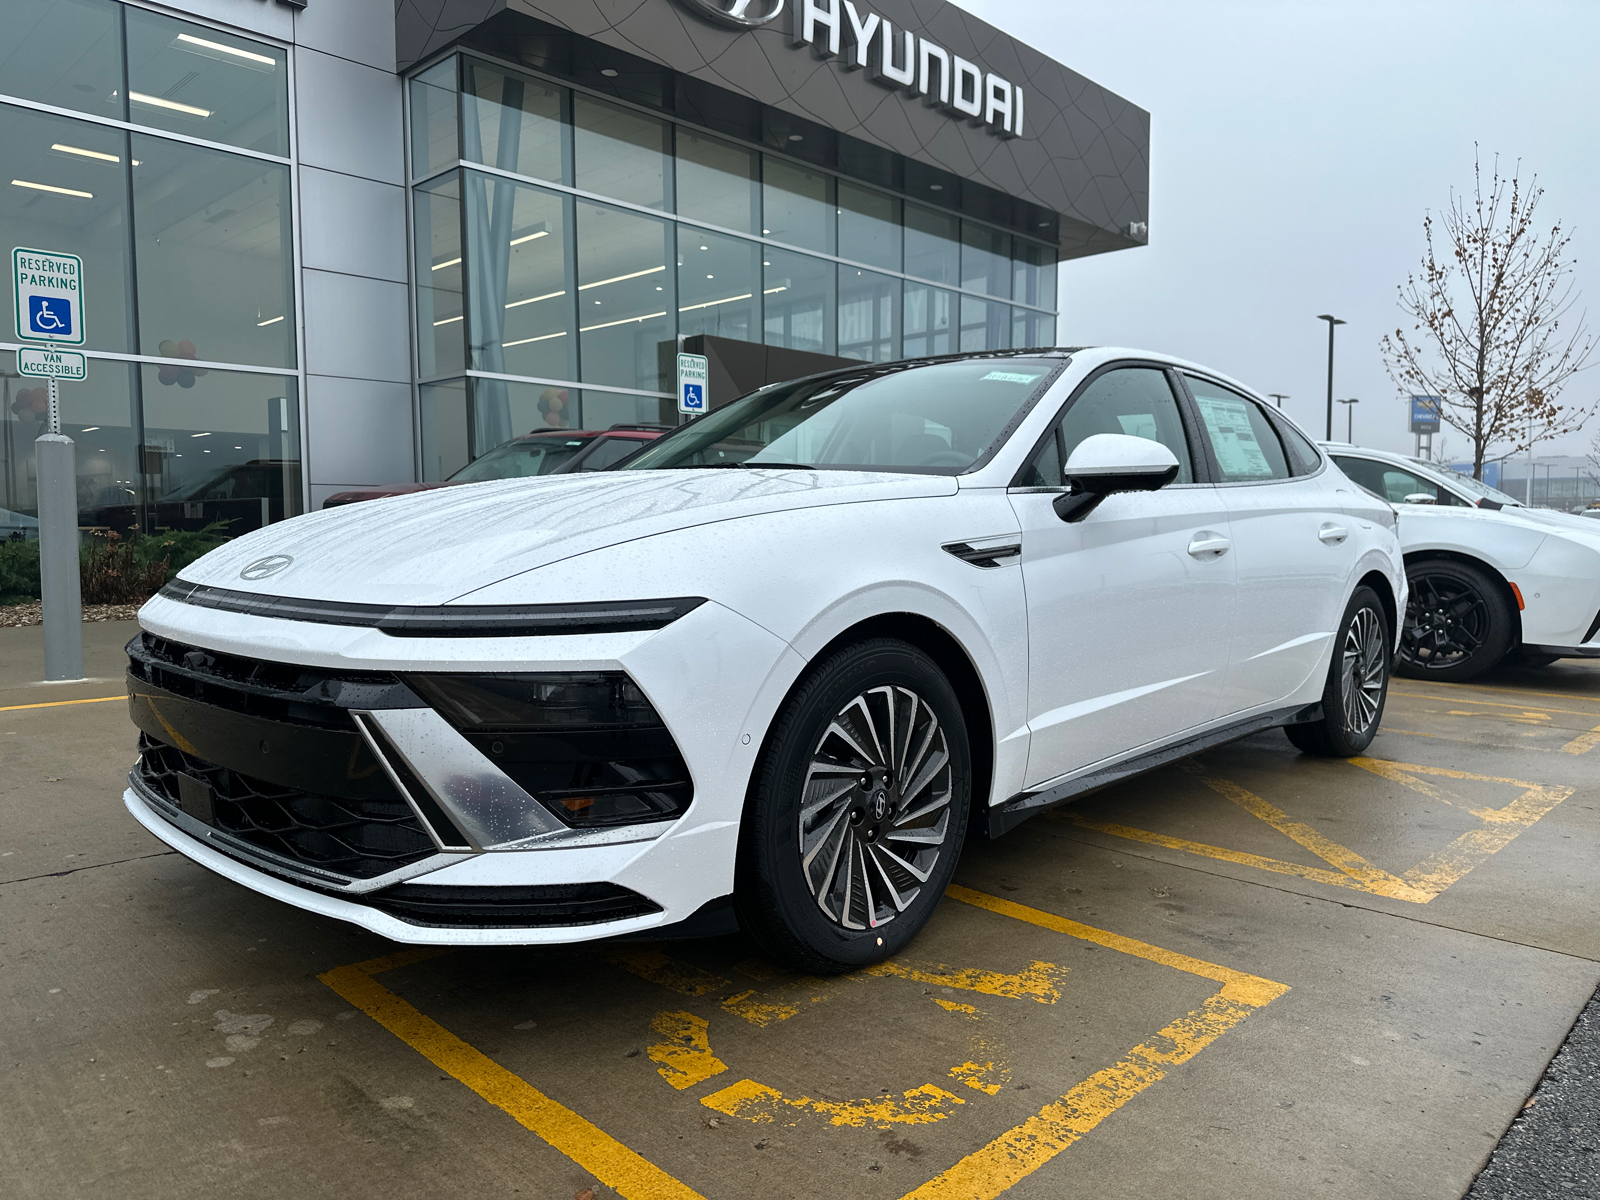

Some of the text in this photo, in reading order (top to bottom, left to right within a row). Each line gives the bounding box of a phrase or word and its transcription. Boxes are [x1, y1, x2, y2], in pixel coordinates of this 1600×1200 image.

[801, 0, 1025, 137] HYUNDAI
[20, 257, 75, 275] RESERVED
[20, 273, 77, 290] PARKING
[43, 353, 62, 363] VAN
[681, 359, 704, 369] RESERVED
[23, 362, 82, 375] ACCESSIBLE
[681, 370, 705, 380] PARKING
[818, 660, 877, 718] KUMHO
